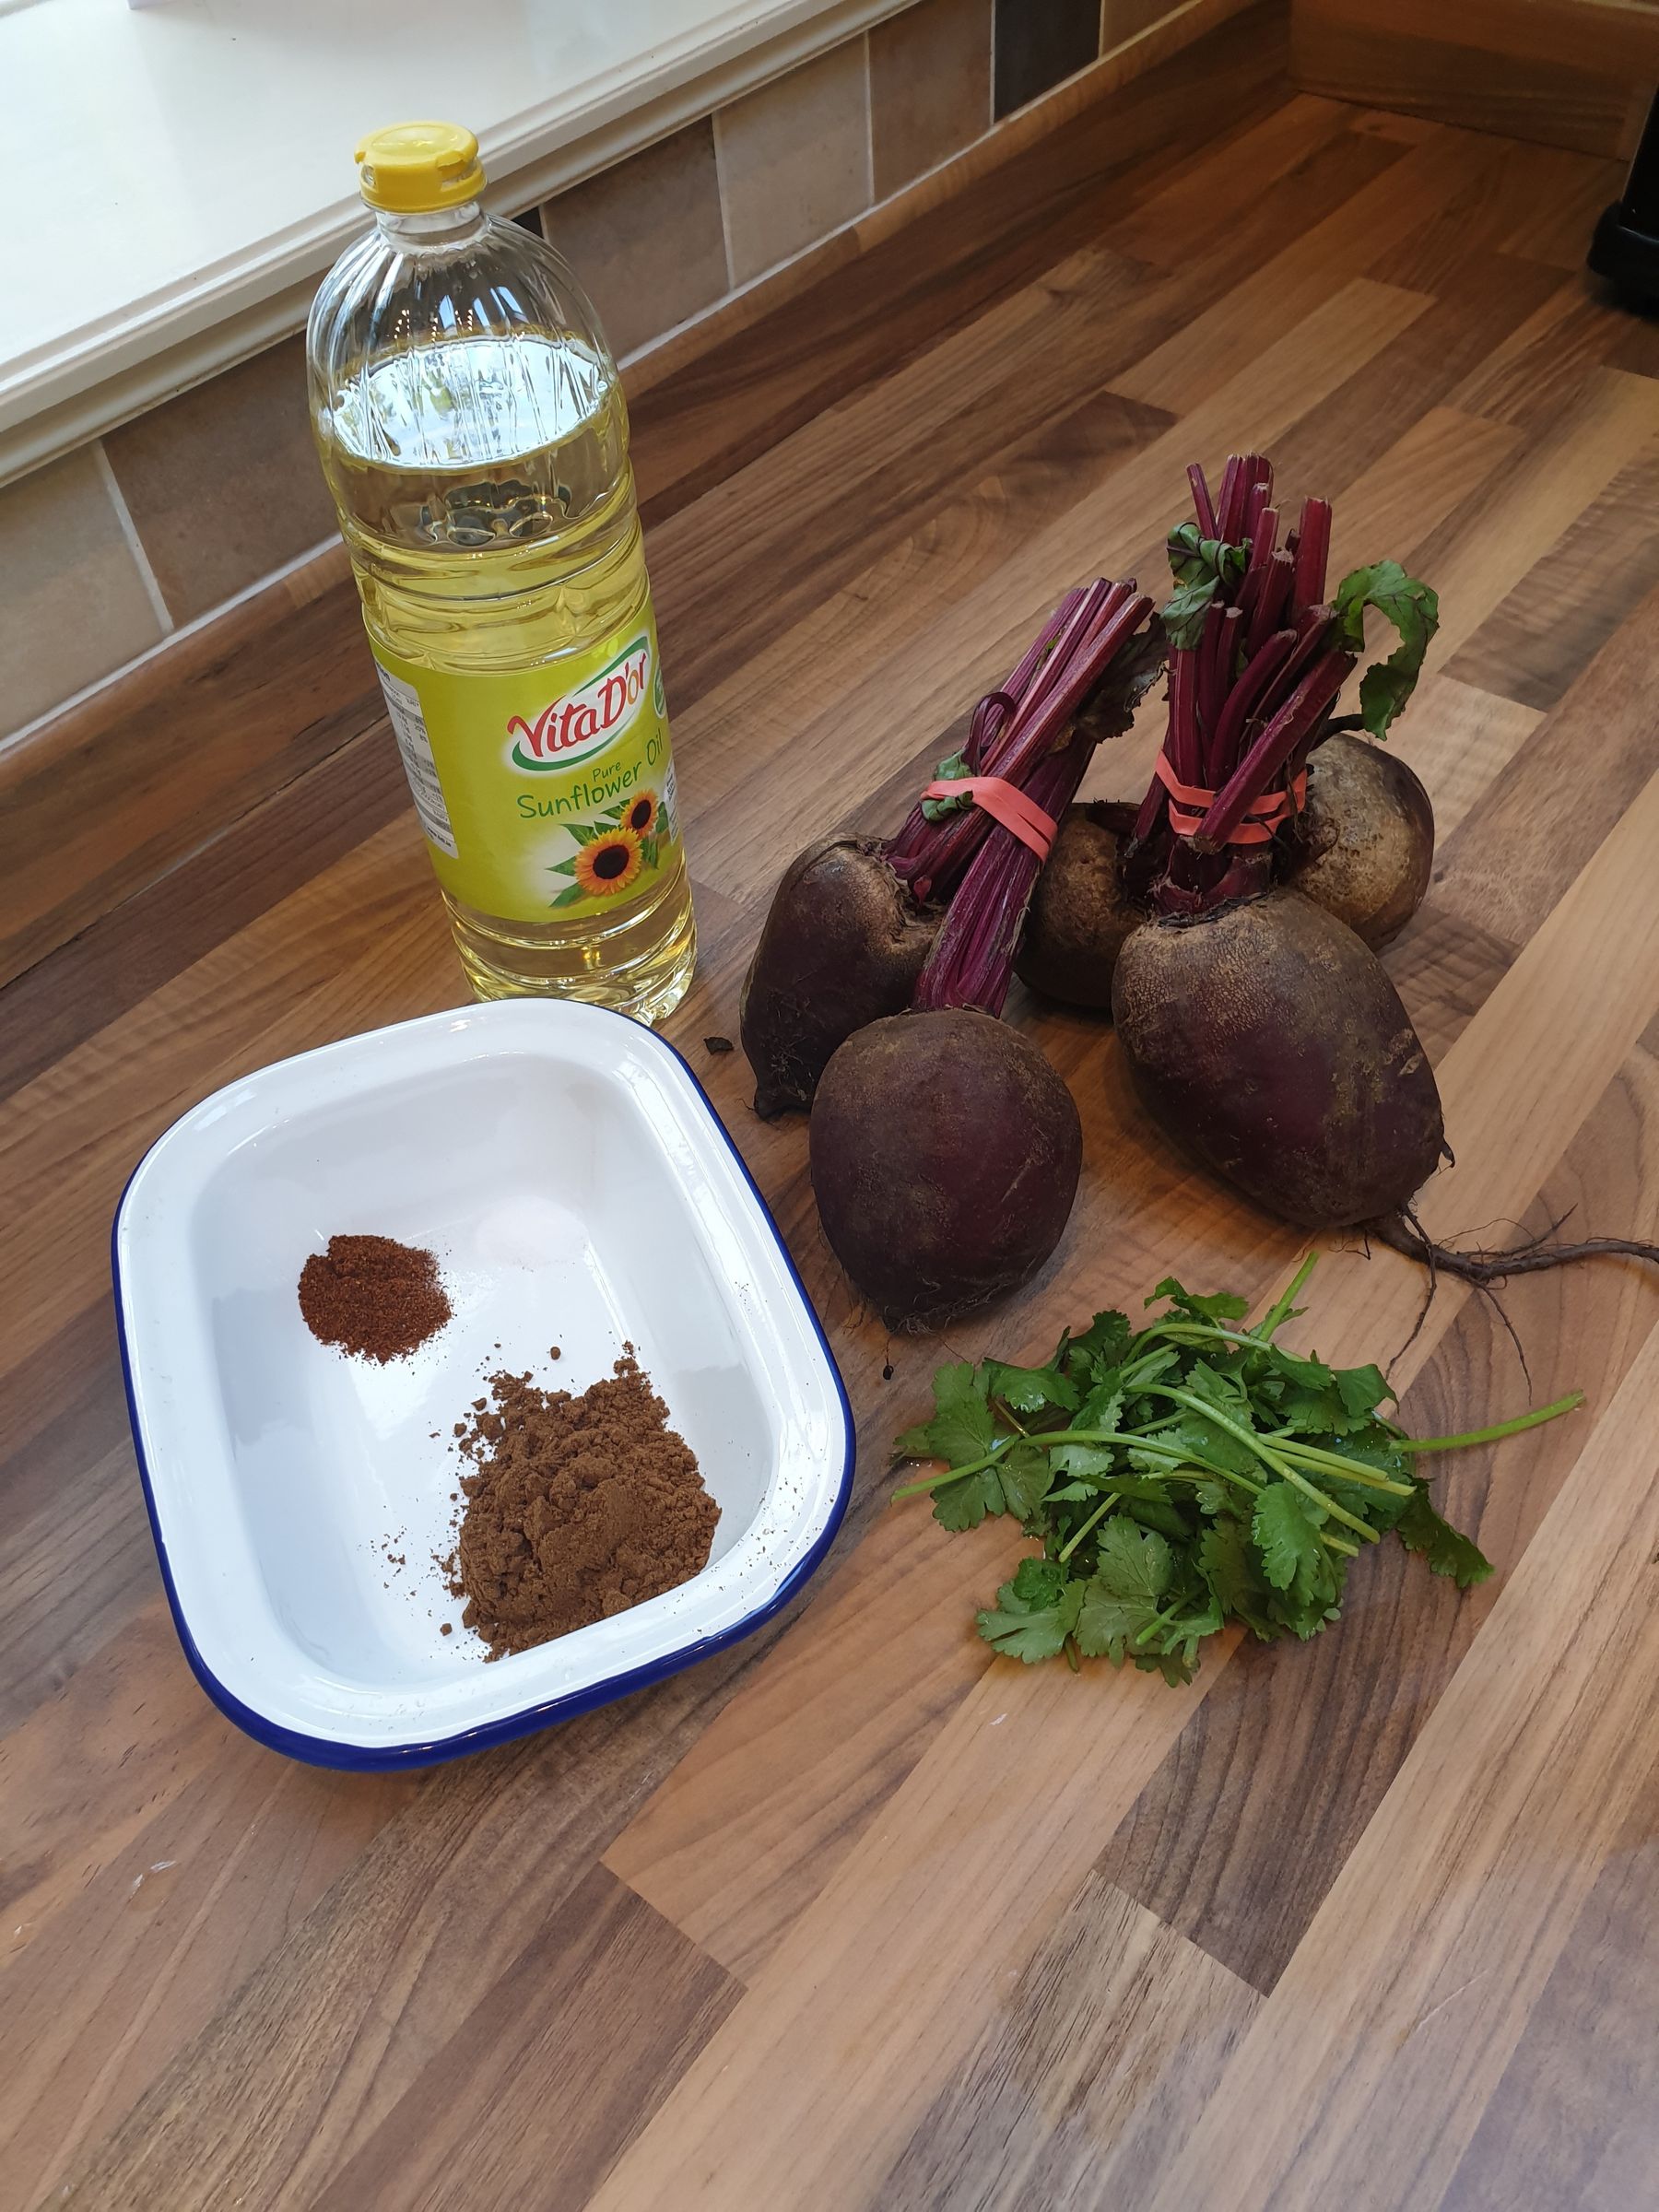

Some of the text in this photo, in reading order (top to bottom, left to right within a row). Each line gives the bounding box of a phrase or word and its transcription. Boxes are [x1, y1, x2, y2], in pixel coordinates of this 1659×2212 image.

[516, 761, 642, 818] Sunflower
[646, 728, 663, 767] Oil
[592, 761, 621, 782] Pure
